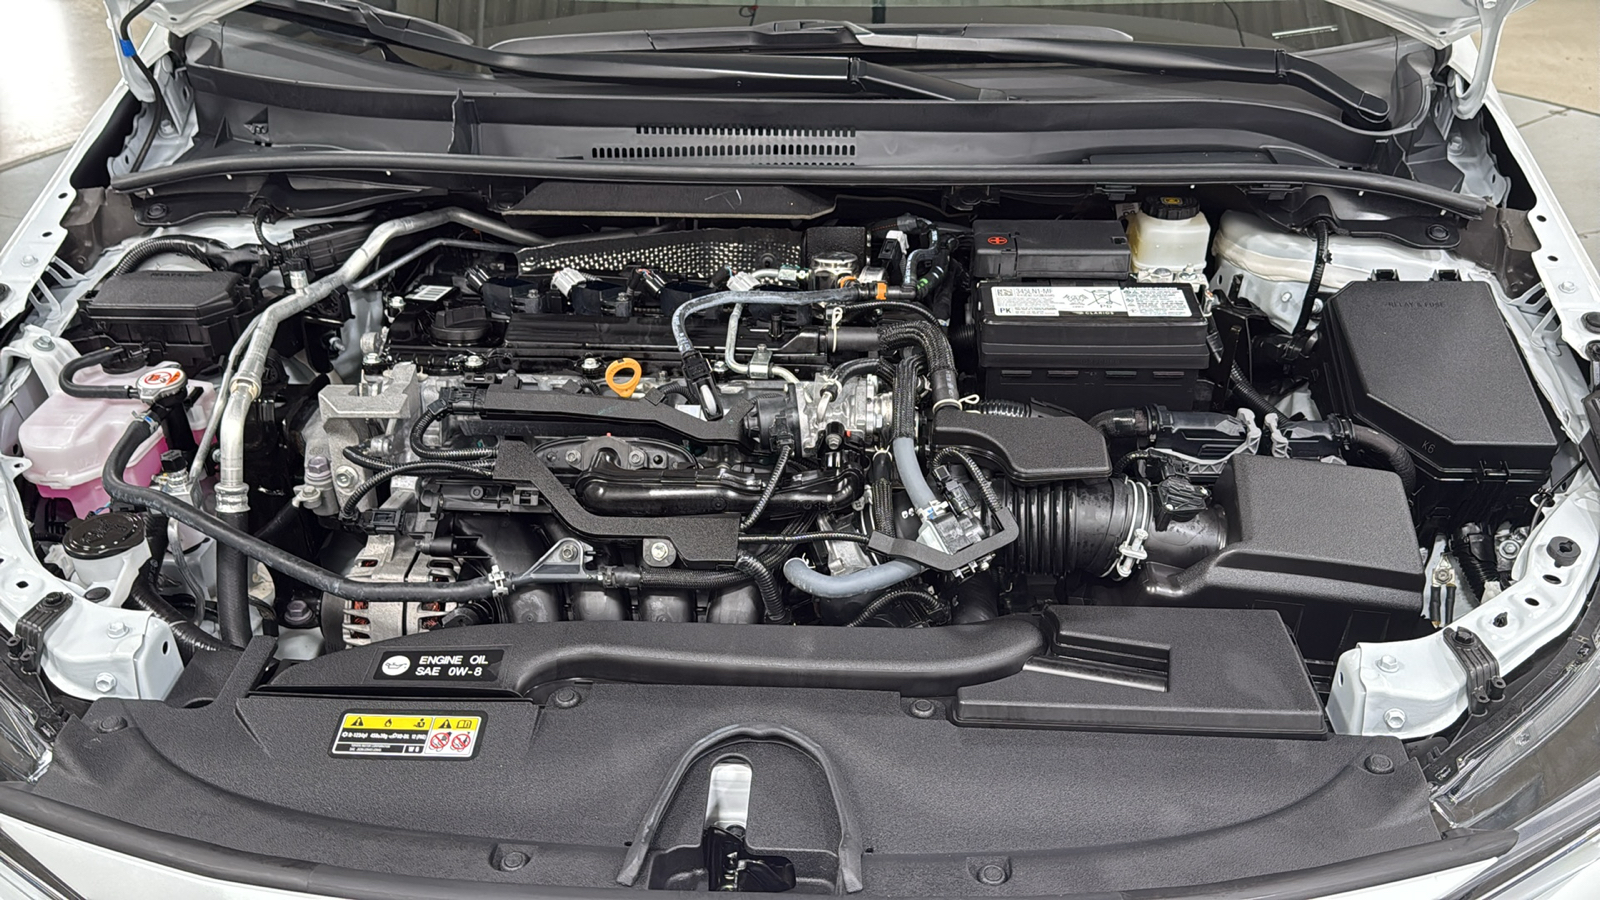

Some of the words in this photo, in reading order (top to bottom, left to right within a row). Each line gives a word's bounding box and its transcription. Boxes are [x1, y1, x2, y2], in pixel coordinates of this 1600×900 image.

[1421, 440, 1436, 454] K6
[418, 655, 464, 665] ENGINE
[469, 655, 489, 665] OIL
[415, 666, 441, 676] SAE
[447, 666, 483, 676] 0W-8
